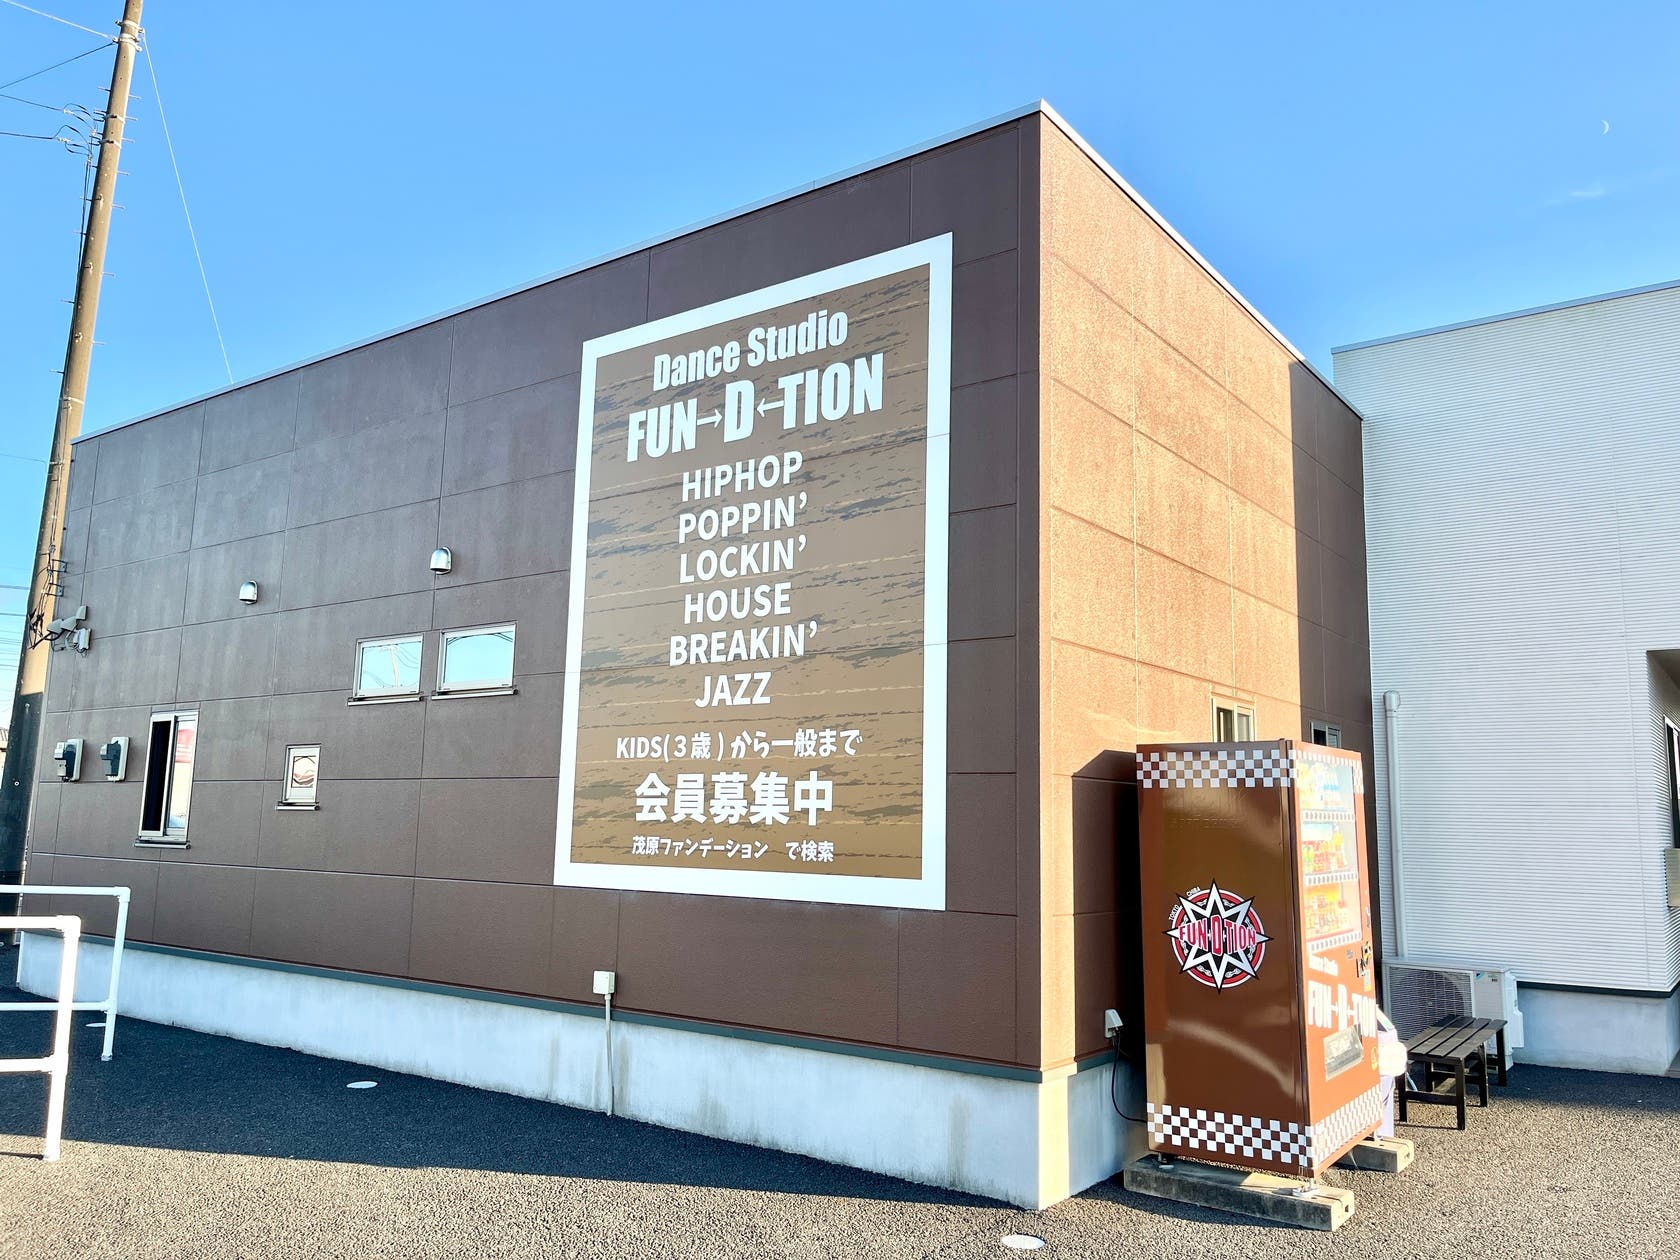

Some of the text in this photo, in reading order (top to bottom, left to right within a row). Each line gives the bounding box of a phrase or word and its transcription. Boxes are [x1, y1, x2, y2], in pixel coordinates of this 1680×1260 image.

[653, 309, 848, 392] Dance Studio
[682, 450, 803, 502] HIPHOP
[684, 581, 792, 625] HOUSE
[694, 671, 772, 708] JAZZ
[634, 770, 833, 826] 会員募集中
[631, 835, 834, 862] 茂原ファンデーション で検索
